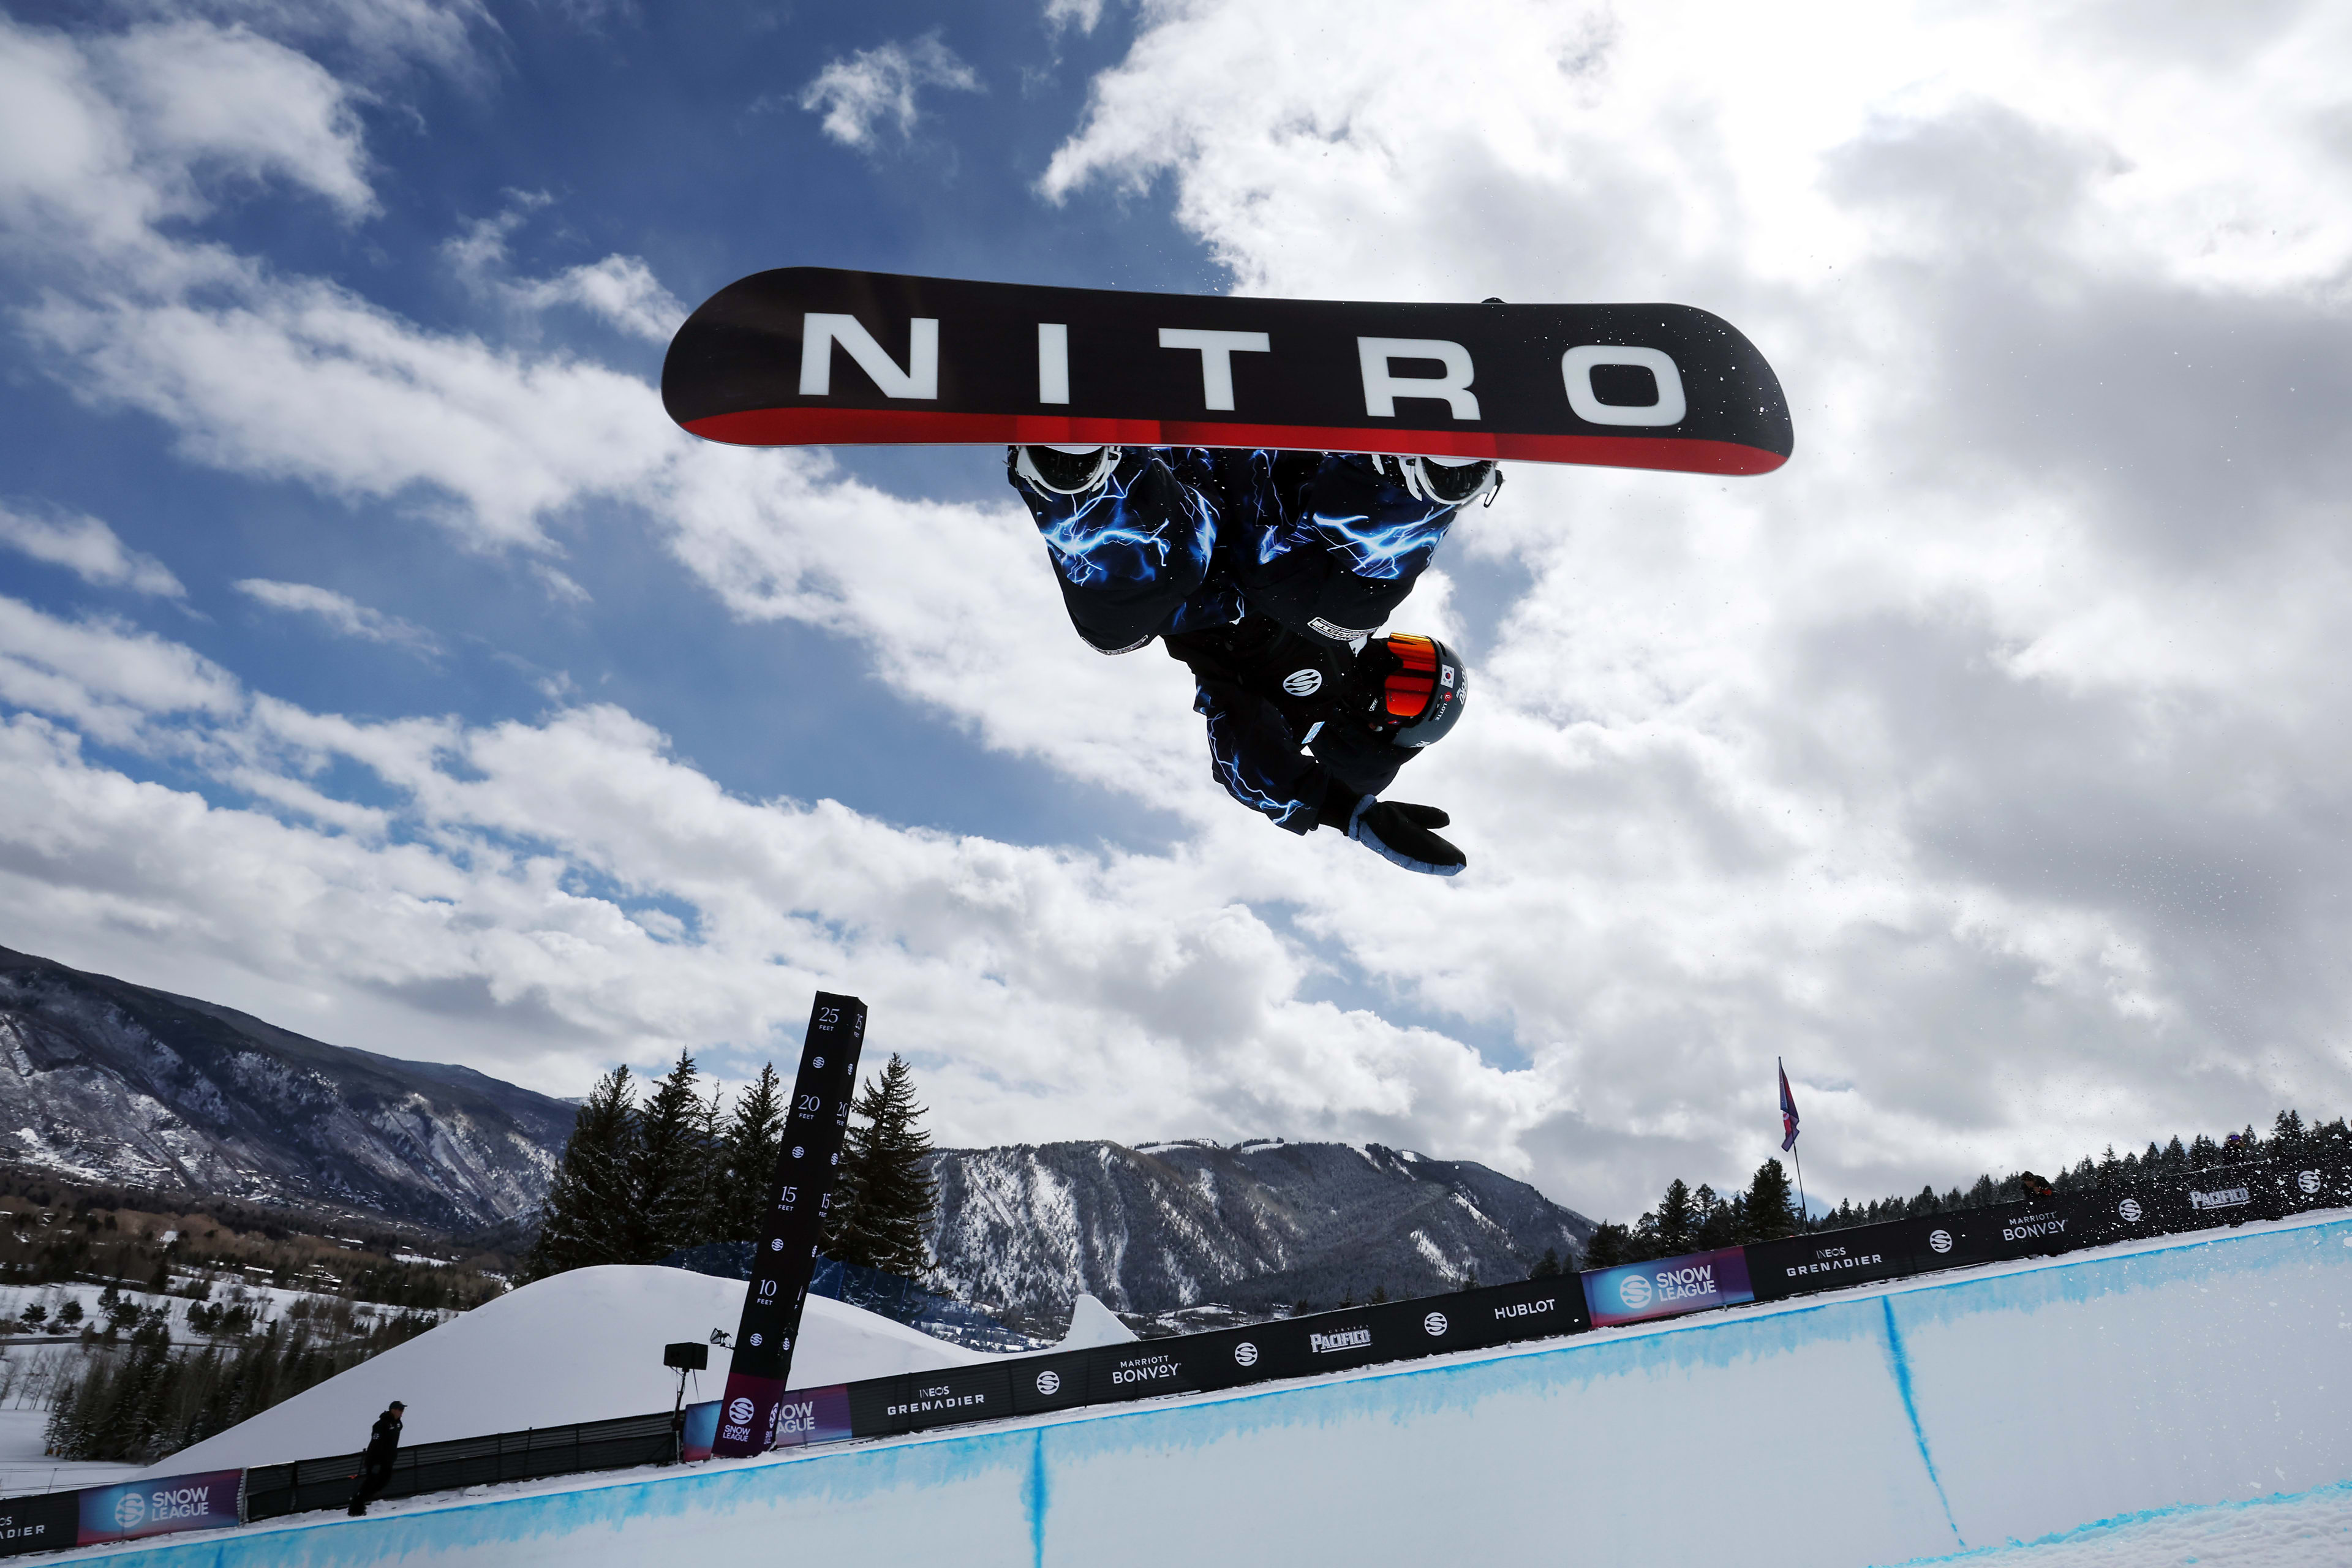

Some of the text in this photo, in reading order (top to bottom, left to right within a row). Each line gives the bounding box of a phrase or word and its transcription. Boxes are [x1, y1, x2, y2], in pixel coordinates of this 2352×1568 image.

[799, 313, 1686, 426] NITRO
[1435, 703, 1447, 721] LOTTE
[818, 1007, 840, 1023] 25
[798, 1095, 820, 1112] 20
[782, 1186, 797, 1202] 15
[821, 1193, 831, 1209] 15
[2009, 1212, 2056, 1226] MARRIOTT
[1816, 1247, 1846, 1259] INEOS
[1786, 1254, 1882, 1277] GRENADIER
[1656, 1265, 1711, 1288] SNOW
[760, 1279, 777, 1296] 10
[1658, 1280, 1716, 1302] LEAGUE
[1494, 1298, 1555, 1319] HUBLOT
[1310, 1329, 1371, 1353] PACIFICO
[1120, 1355, 1169, 1368] MARRIOTT
[1112, 1363, 1179, 1384] BONVOY
[919, 1385, 949, 1398] INEOS
[778, 1401, 813, 1421] OW
[887, 1394, 984, 1415] GRENADIER
[725, 1424, 751, 1436] SNOW
[776, 1416, 816, 1434] AGUE
[722, 1431, 749, 1442] LEAGUE
[152, 1486, 209, 1508] SNOW
[151, 1502, 209, 1522] LEAGUE
